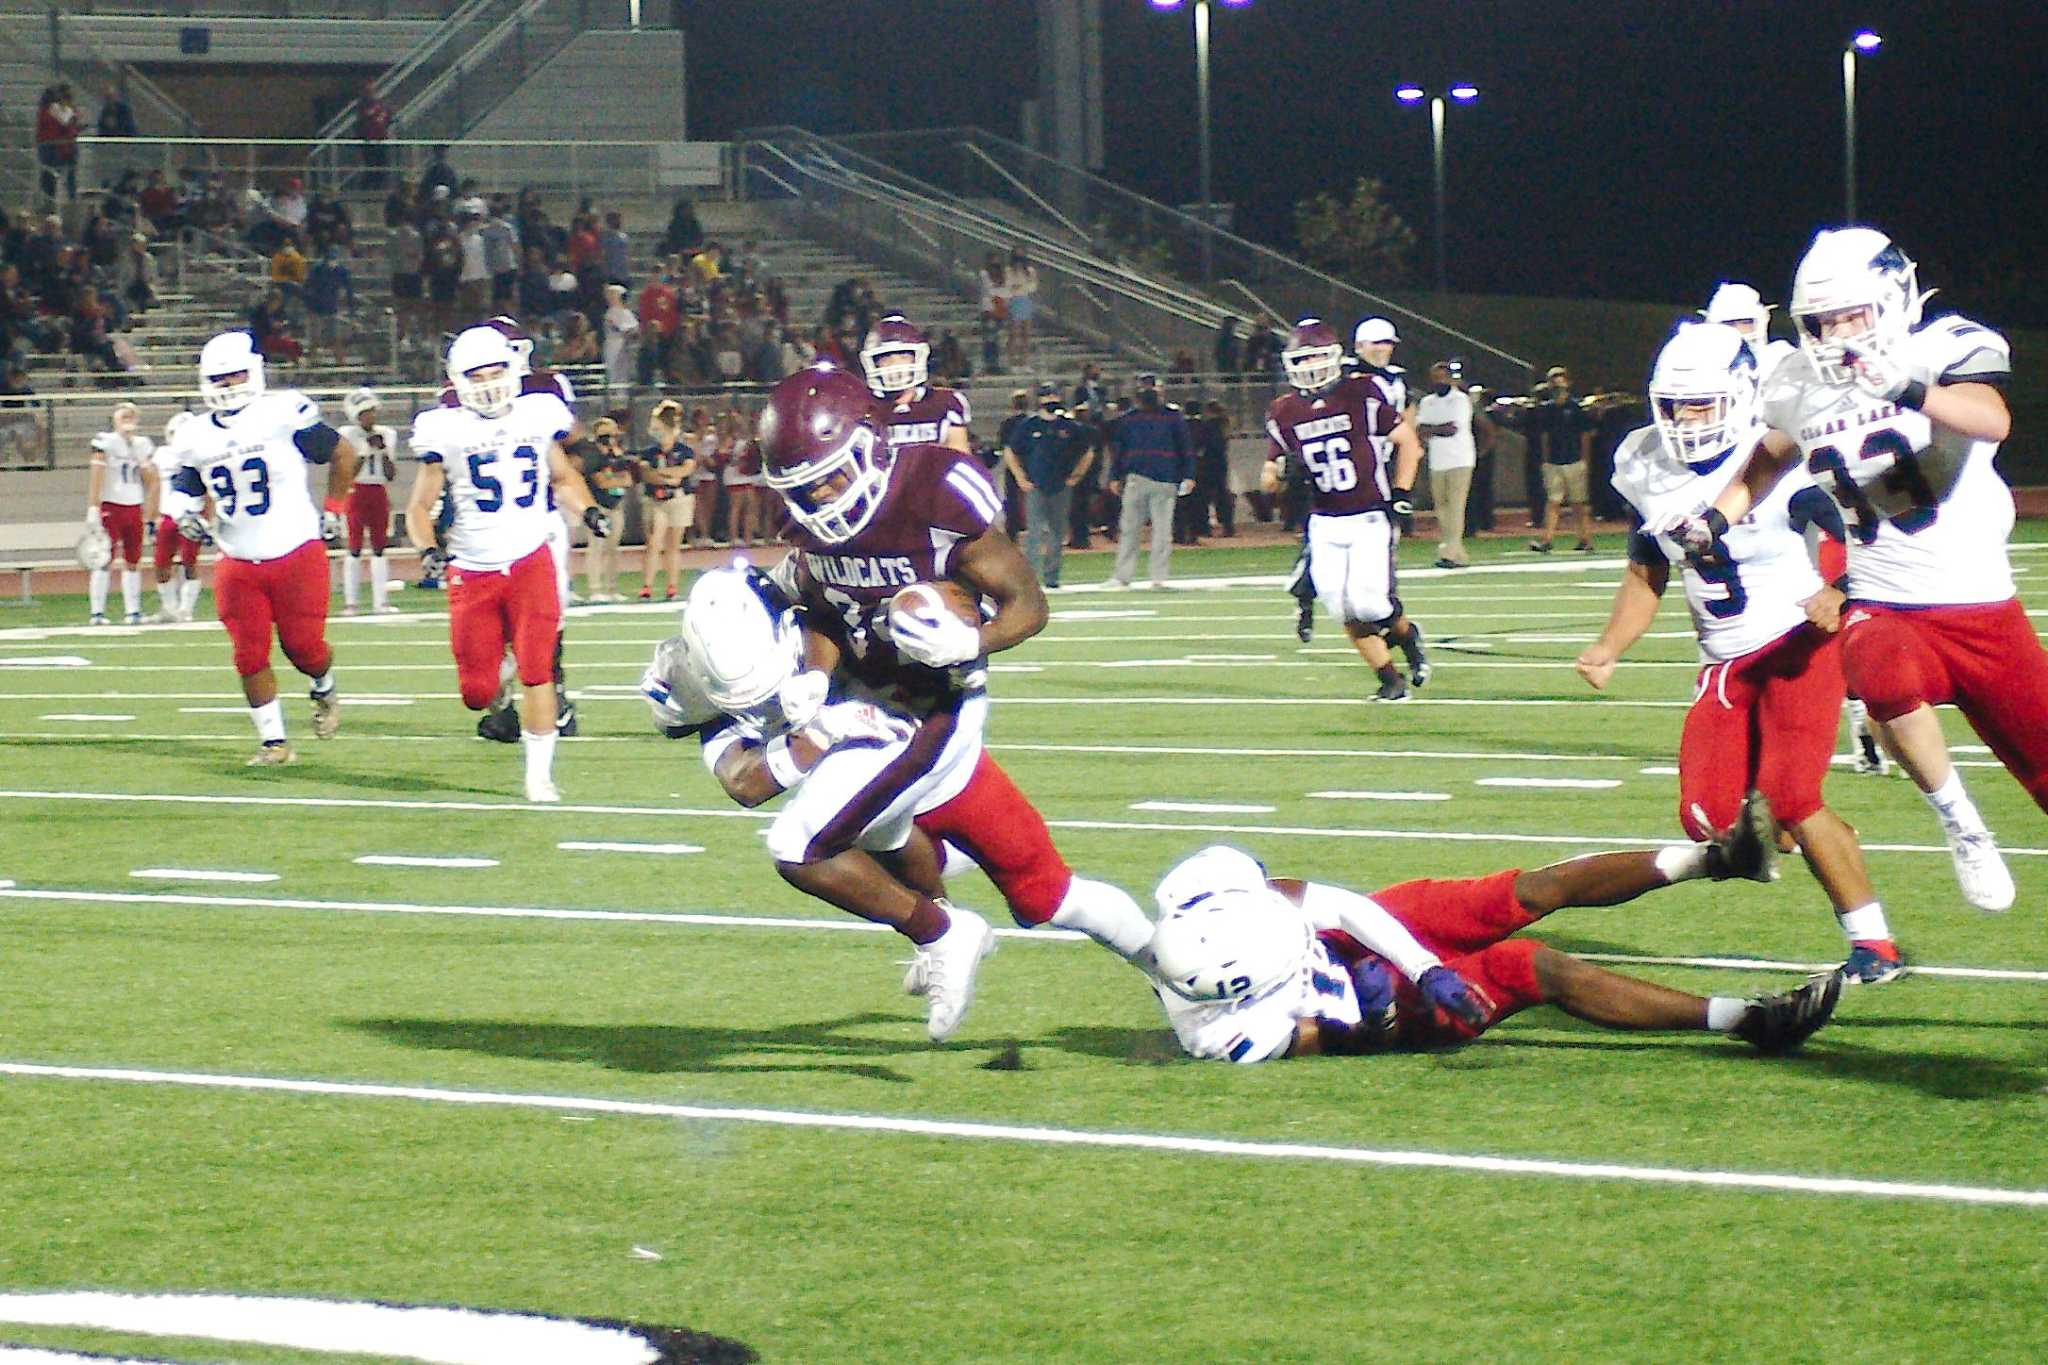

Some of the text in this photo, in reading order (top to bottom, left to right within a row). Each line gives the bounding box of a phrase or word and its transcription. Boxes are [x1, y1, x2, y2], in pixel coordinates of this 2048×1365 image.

[467, 446, 538, 513] 53
[1301, 437, 1358, 493] 56
[804, 552, 918, 588] WILDCATS
